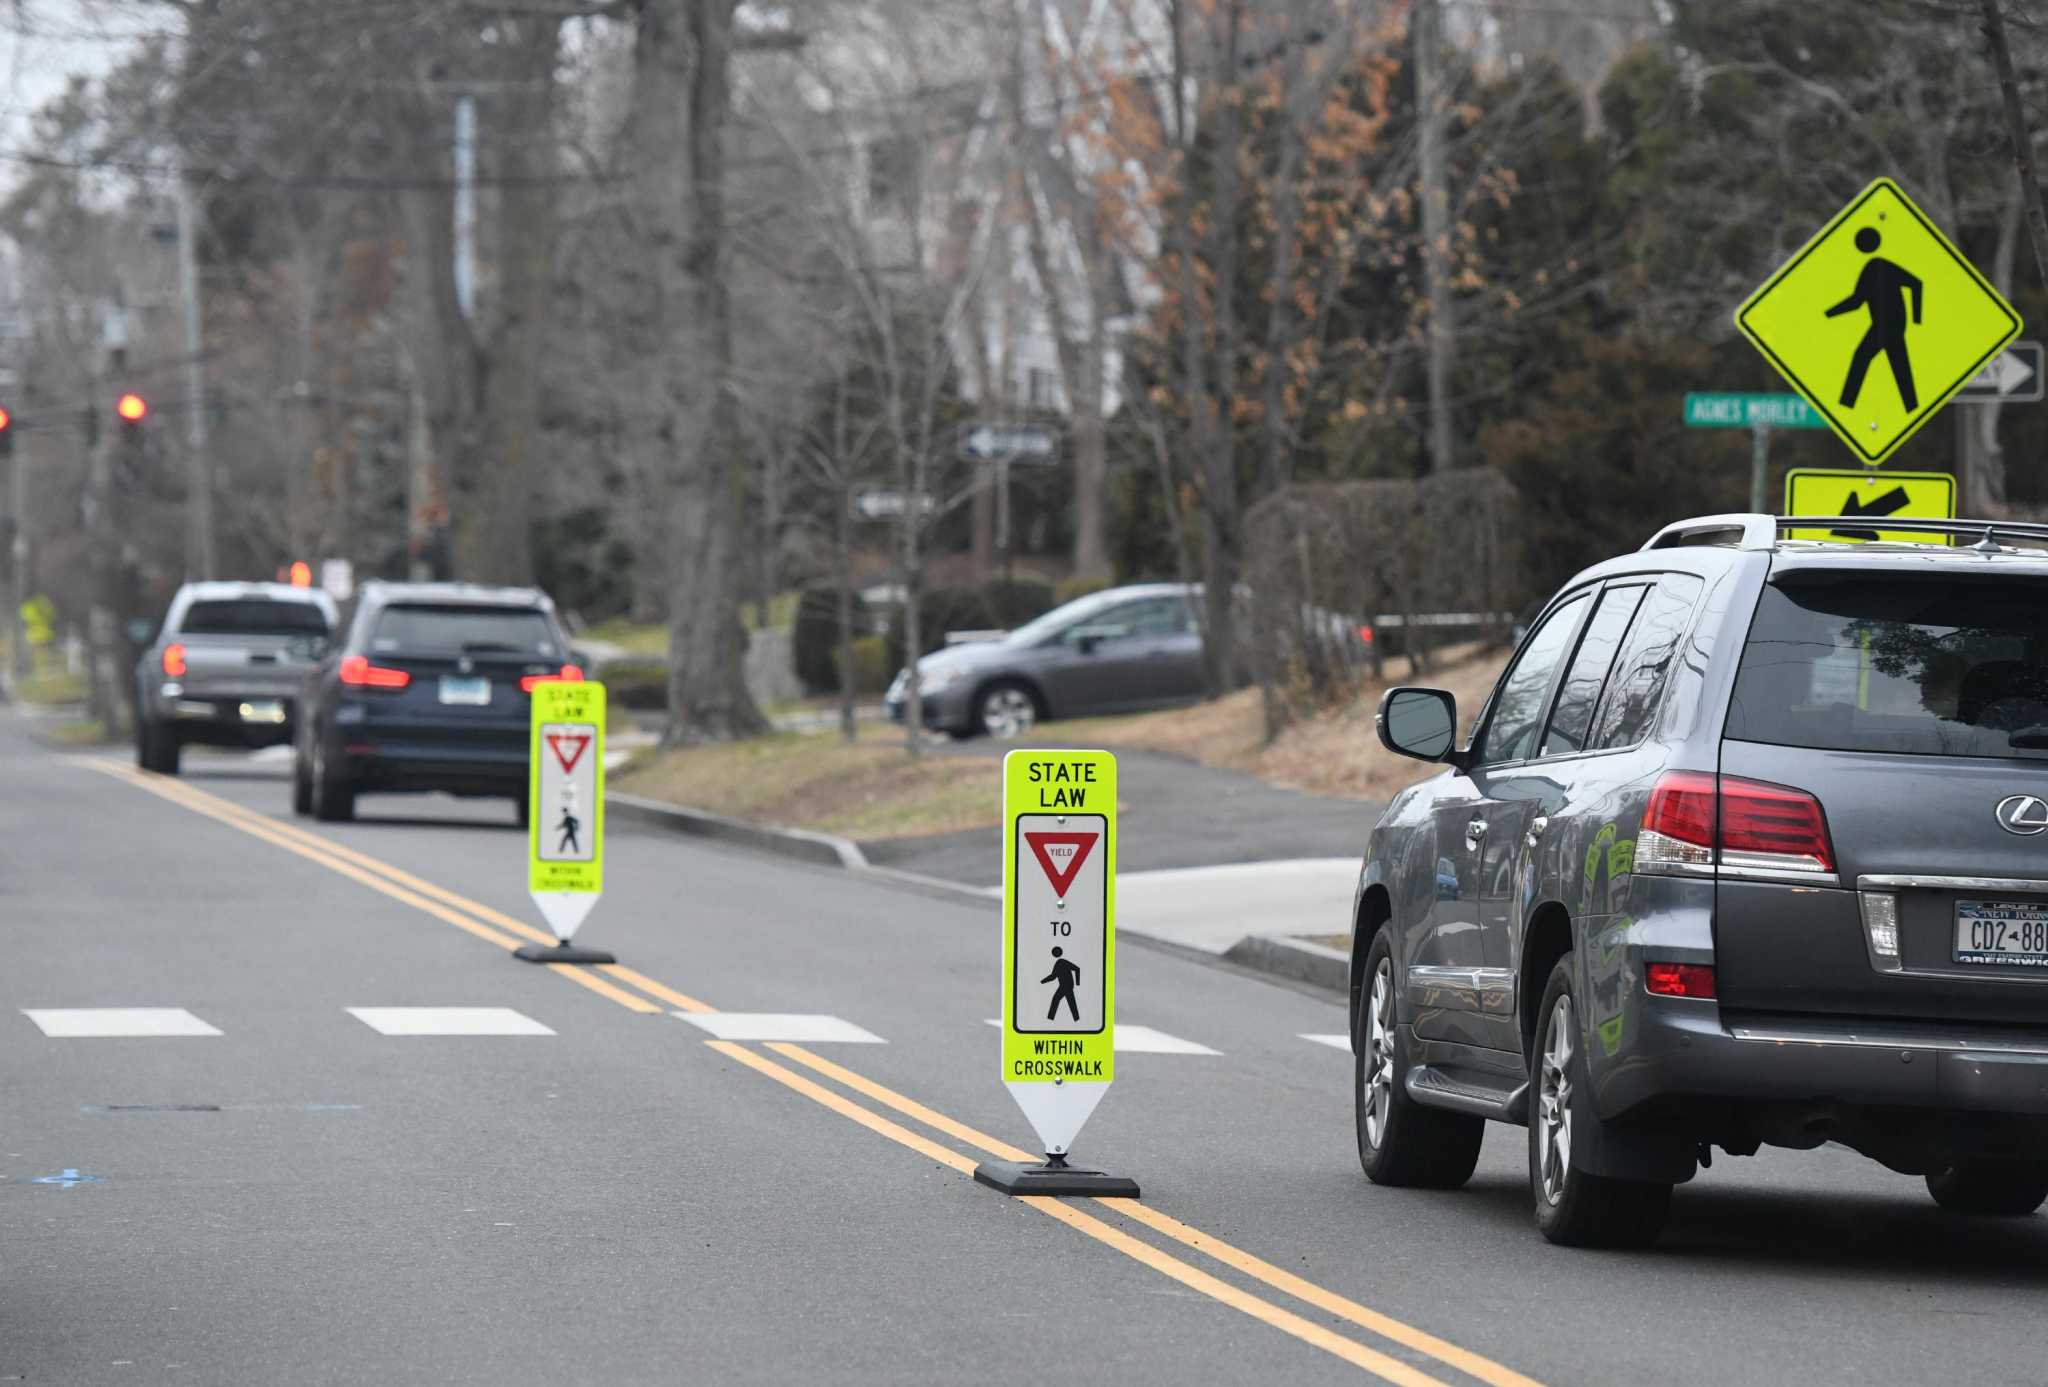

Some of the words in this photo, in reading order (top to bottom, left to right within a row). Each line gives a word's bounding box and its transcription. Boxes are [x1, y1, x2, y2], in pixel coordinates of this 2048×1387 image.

[1693, 398, 1742, 422] AGNES
[1747, 399, 1807, 423] MORLEY
[1028, 762, 1097, 783] STATE
[1040, 788, 1086, 808] LAW
[1050, 847, 1073, 857] YIELD
[1050, 921, 1072, 937] TO
[1034, 1040, 1083, 1055] WITHIN
[1014, 1060, 1102, 1076] CROSSWALK
